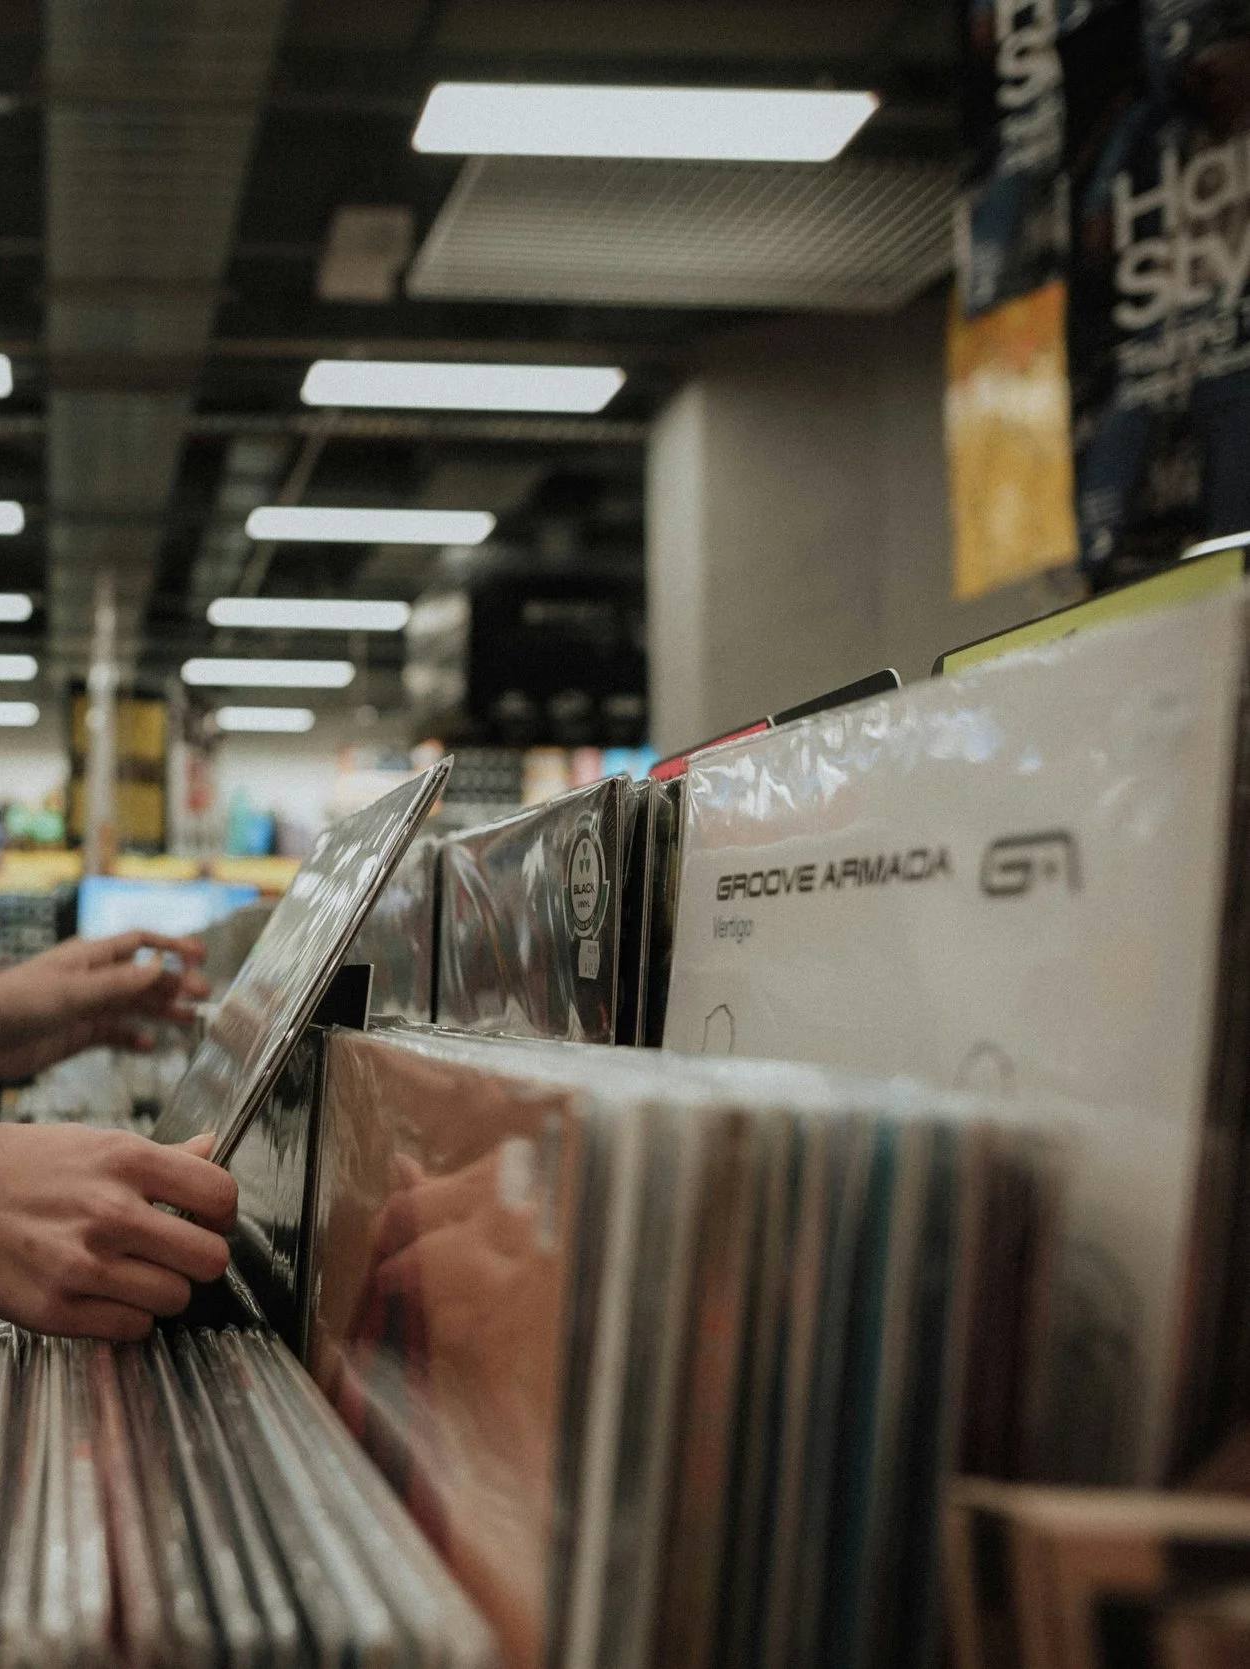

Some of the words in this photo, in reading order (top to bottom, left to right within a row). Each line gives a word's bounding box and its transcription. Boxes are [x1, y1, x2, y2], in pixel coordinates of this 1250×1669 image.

[573, 882, 596, 895] BLACK
[716, 864, 817, 901] GROOVE
[822, 846, 953, 890] ARMADA
[712, 914, 754, 944] Vertigo
